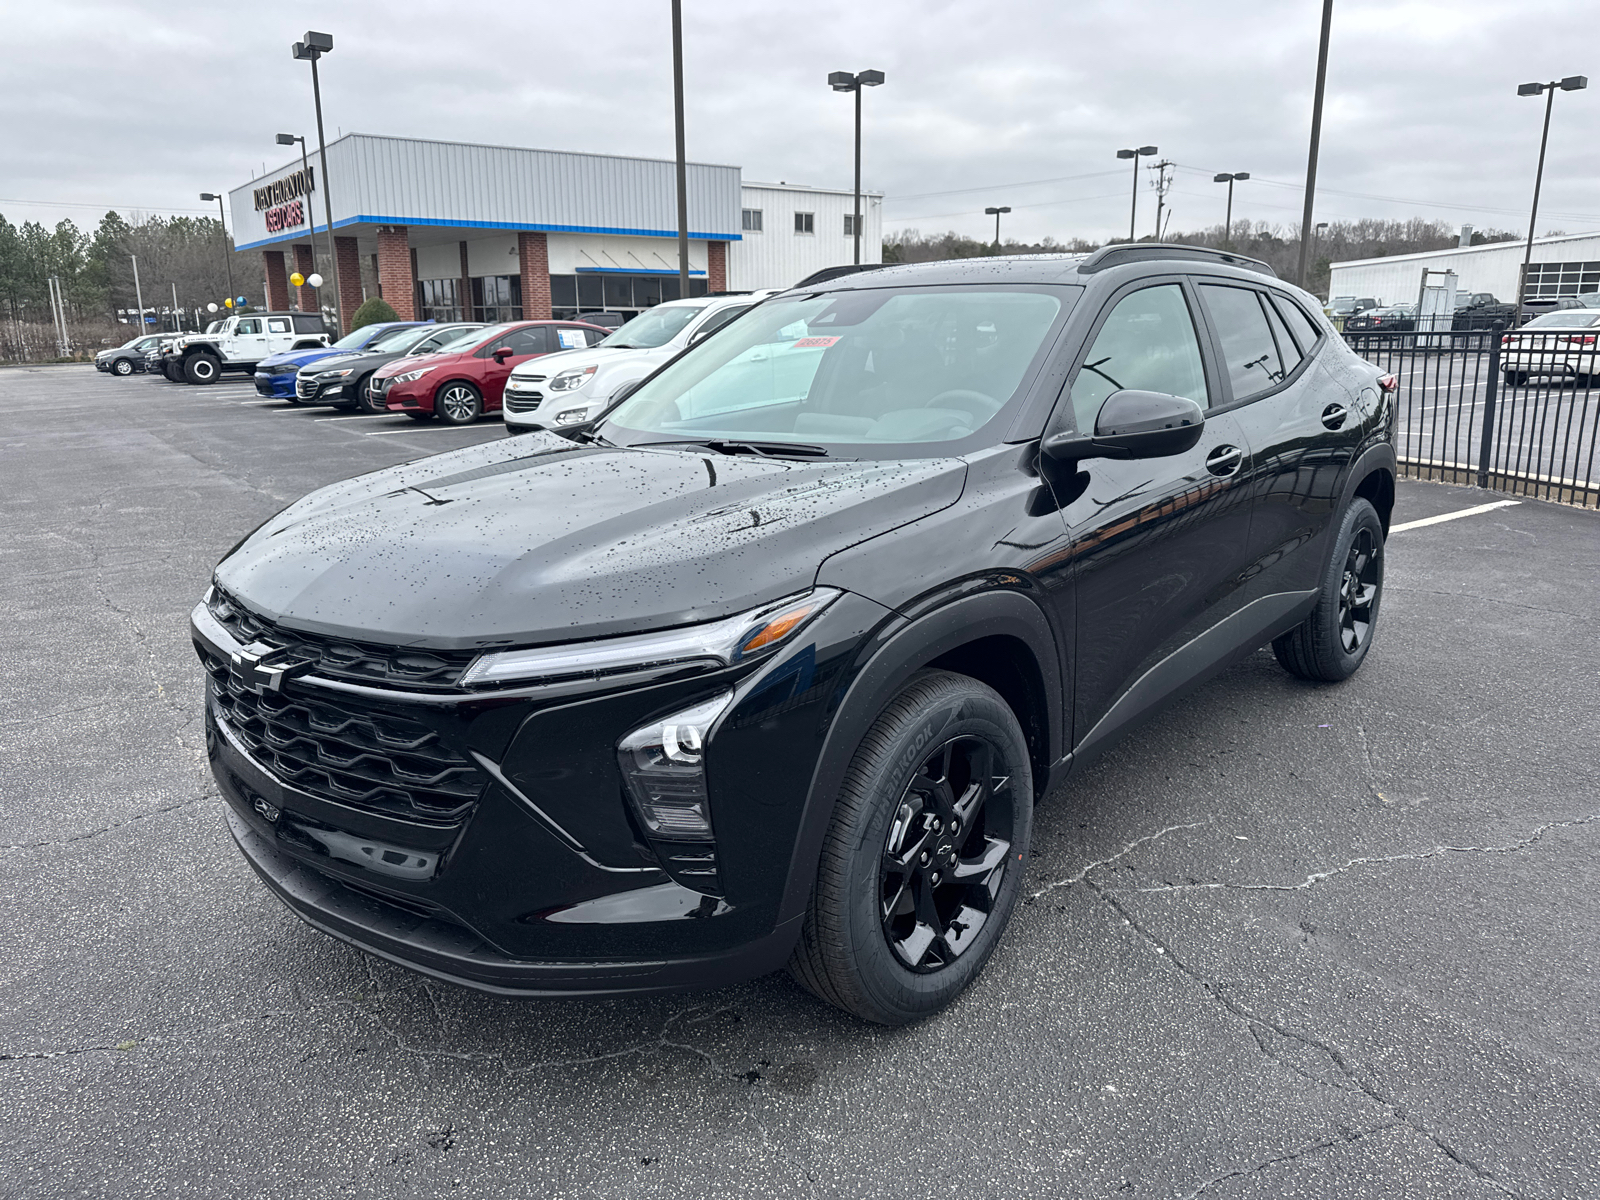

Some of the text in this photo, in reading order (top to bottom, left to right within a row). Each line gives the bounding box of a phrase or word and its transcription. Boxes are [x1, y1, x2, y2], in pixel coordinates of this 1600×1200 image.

[253, 166, 315, 211] JOHN THORNTON
[265, 200, 304, 233] USED CARS
